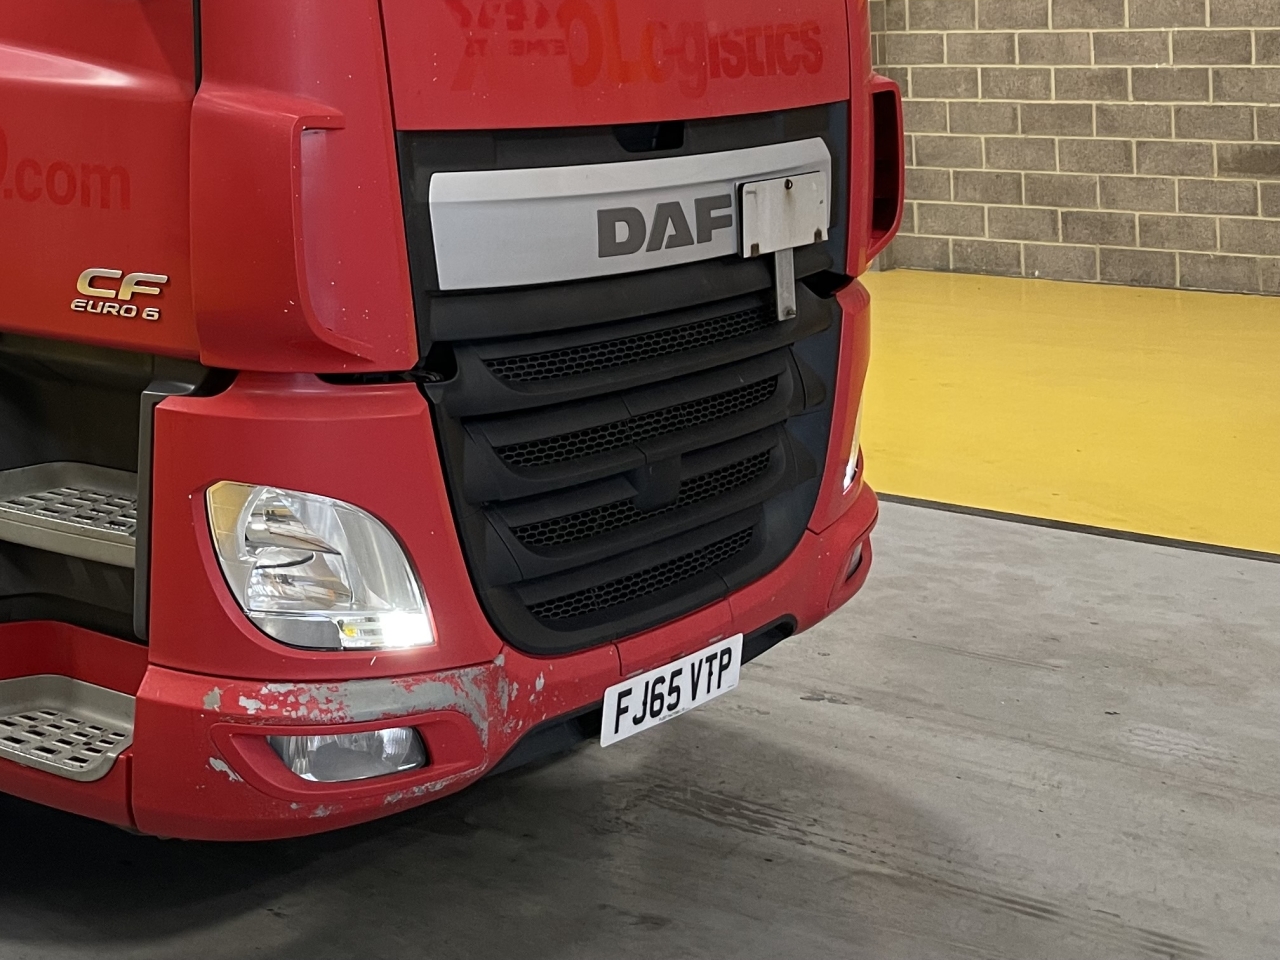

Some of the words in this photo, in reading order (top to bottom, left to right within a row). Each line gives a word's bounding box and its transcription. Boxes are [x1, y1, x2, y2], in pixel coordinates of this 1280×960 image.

[597, 193, 733, 259] DAF
[76, 268, 168, 300] CF
[70, 299, 138, 318] EURO
[141, 307, 160, 321] 6
[614, 667, 684, 735] FJ65
[690, 646, 733, 702] VTP
